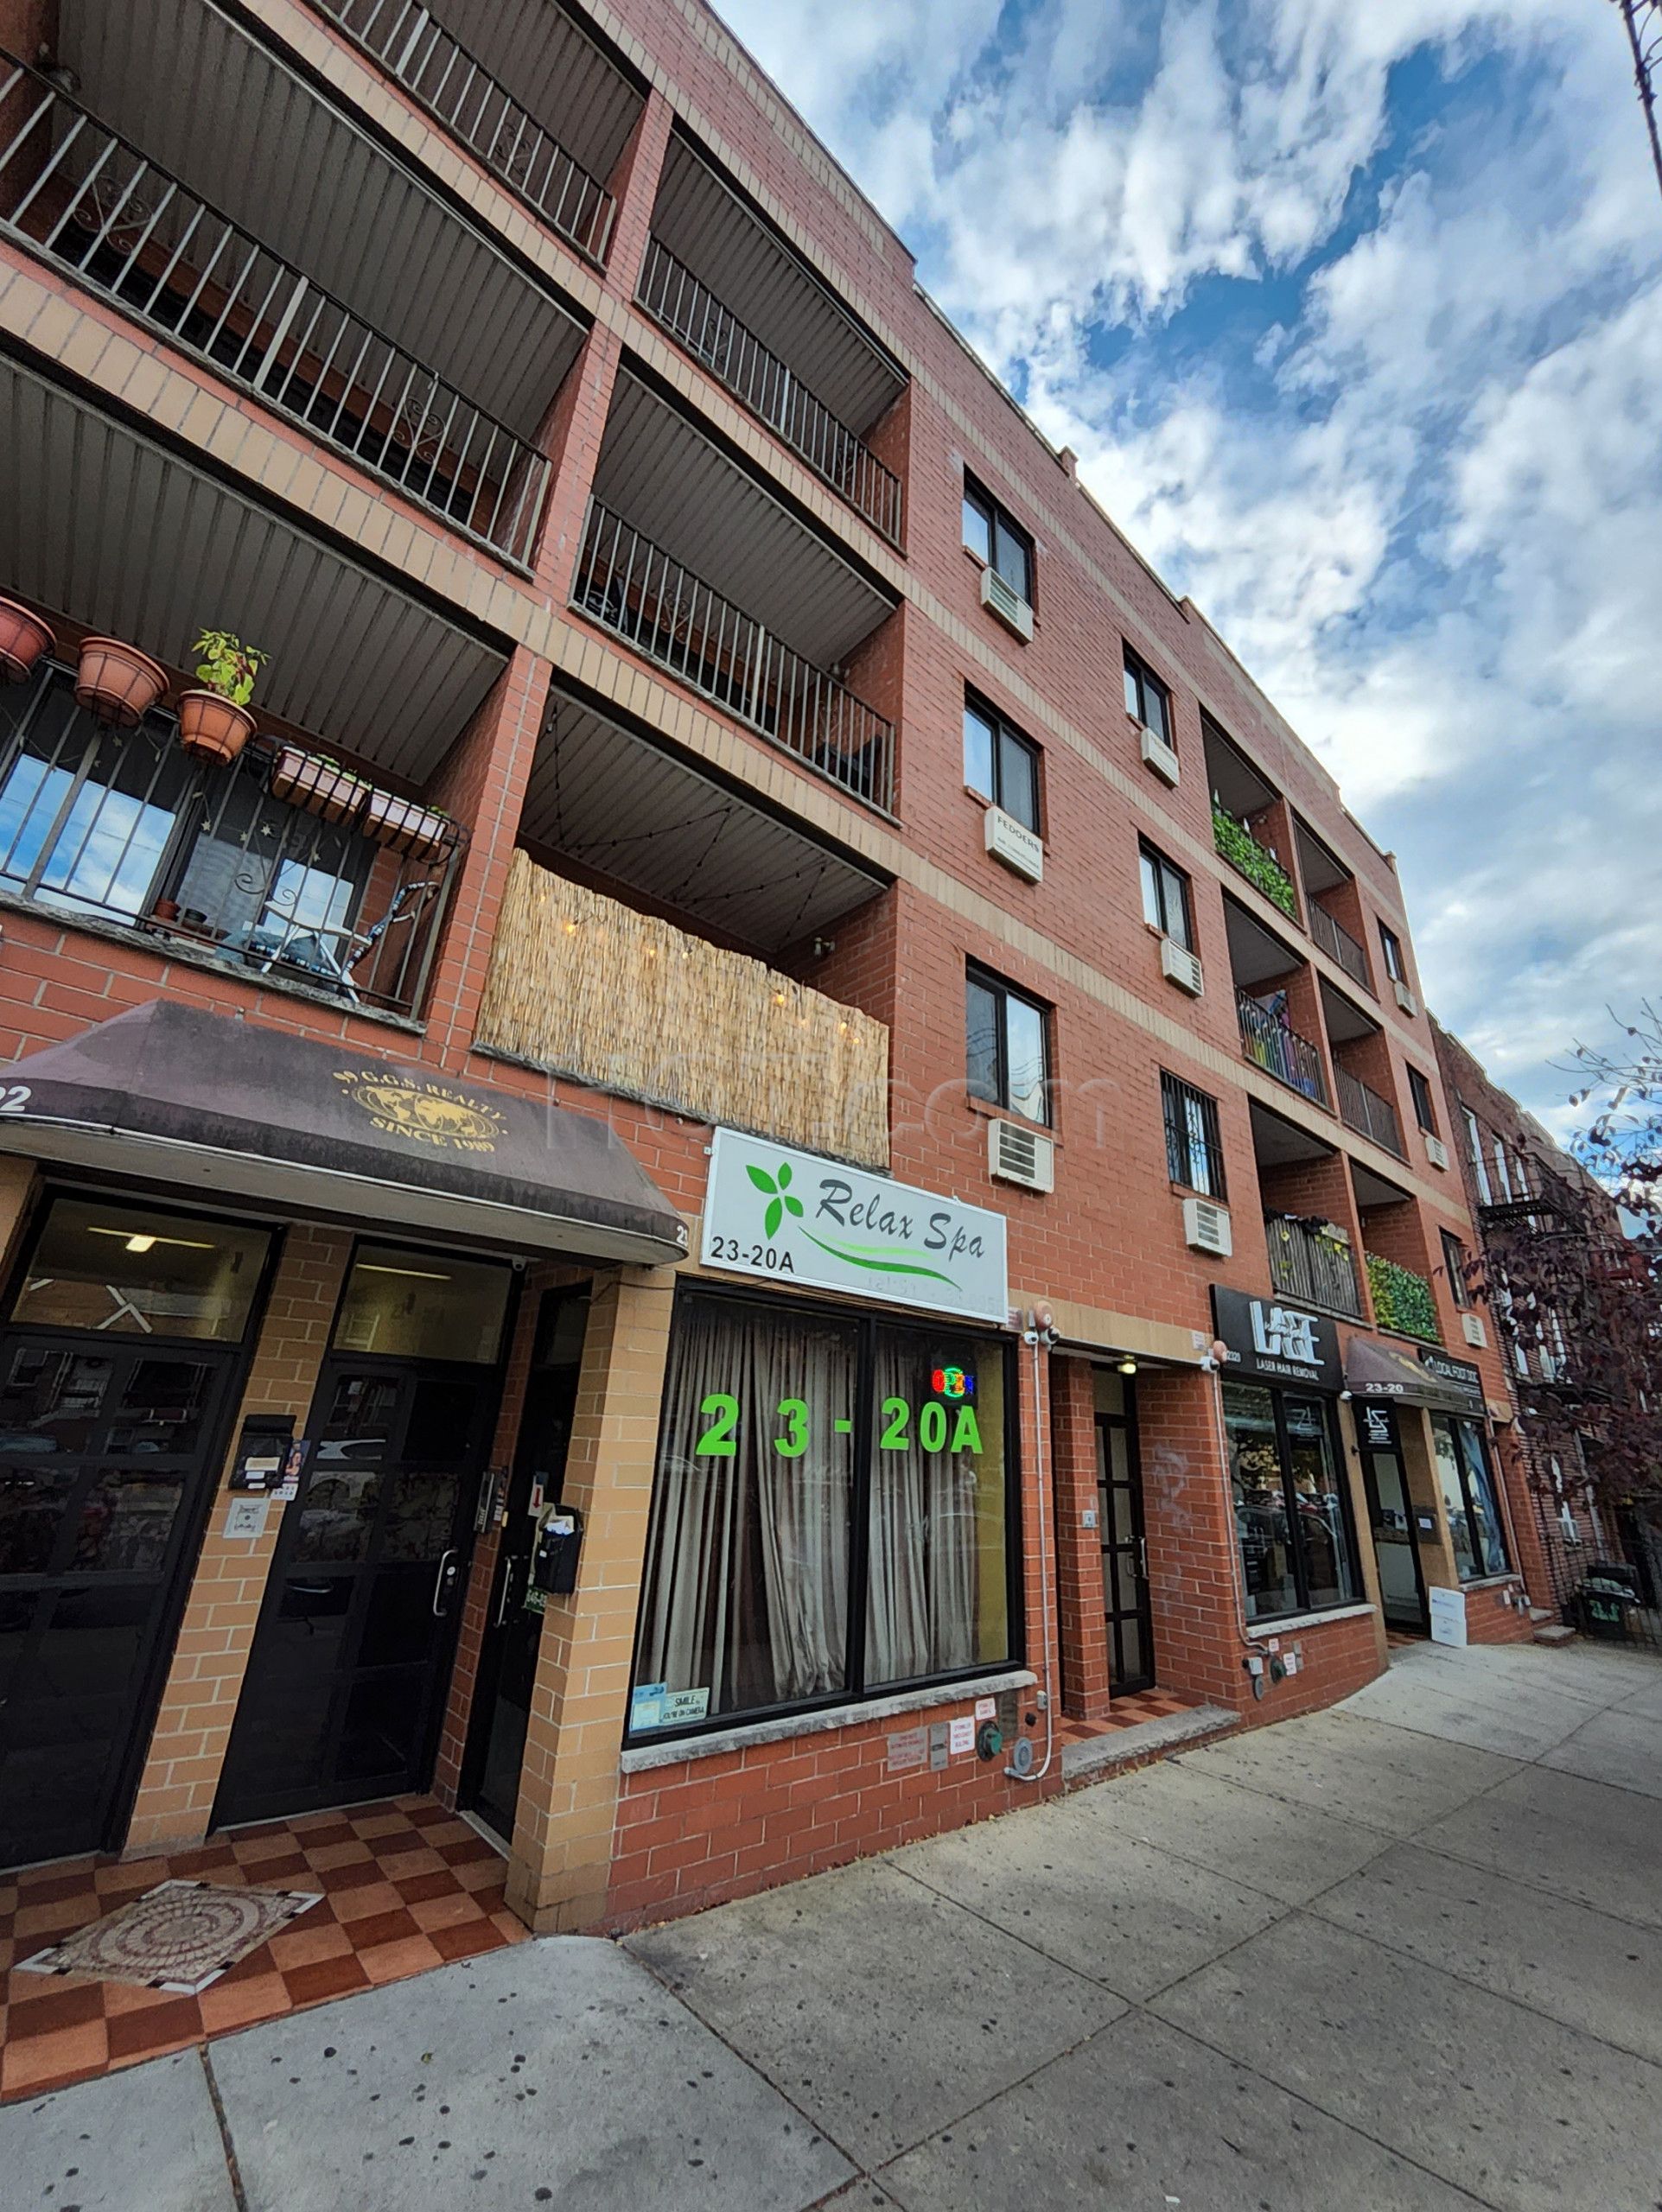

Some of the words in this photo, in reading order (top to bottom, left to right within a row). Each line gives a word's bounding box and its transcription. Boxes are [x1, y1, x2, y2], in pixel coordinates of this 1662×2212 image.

[0, 1085, 31, 1111] 2
[426, 1084, 507, 1120] REALTY
[370, 1116, 448, 1147] SINCE
[816, 1179, 914, 1239] Relax
[924, 1212, 985, 1262] Spa
[710, 1236, 795, 1274] 23-20A
[1257, 1358, 1276, 1373] LASER
[1277, 1363, 1292, 1375] HAIR
[1293, 1365, 1319, 1381] REMOVAL
[1366, 1382, 1404, 1393] 23-20
